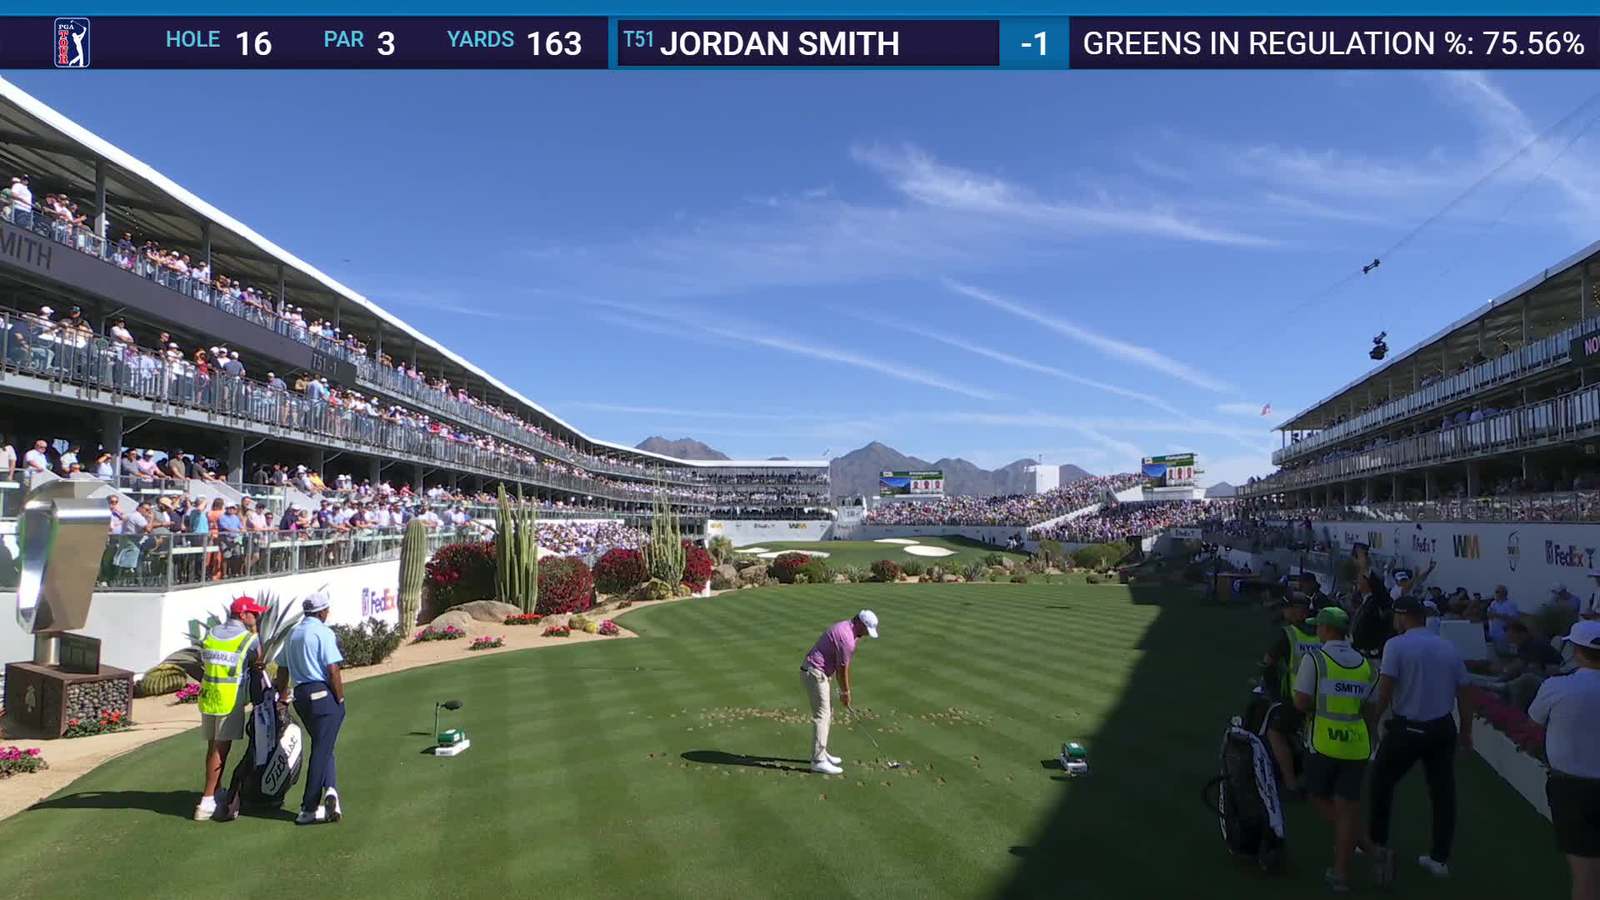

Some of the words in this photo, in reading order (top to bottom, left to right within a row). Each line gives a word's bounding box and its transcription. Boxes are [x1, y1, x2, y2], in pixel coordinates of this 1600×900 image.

[1584, 336, 1600, 357] NO
[1452, 534, 1480, 560] WM
[1554, 543, 1584, 568] FedEx
[370, 587, 396, 615] FedEx
